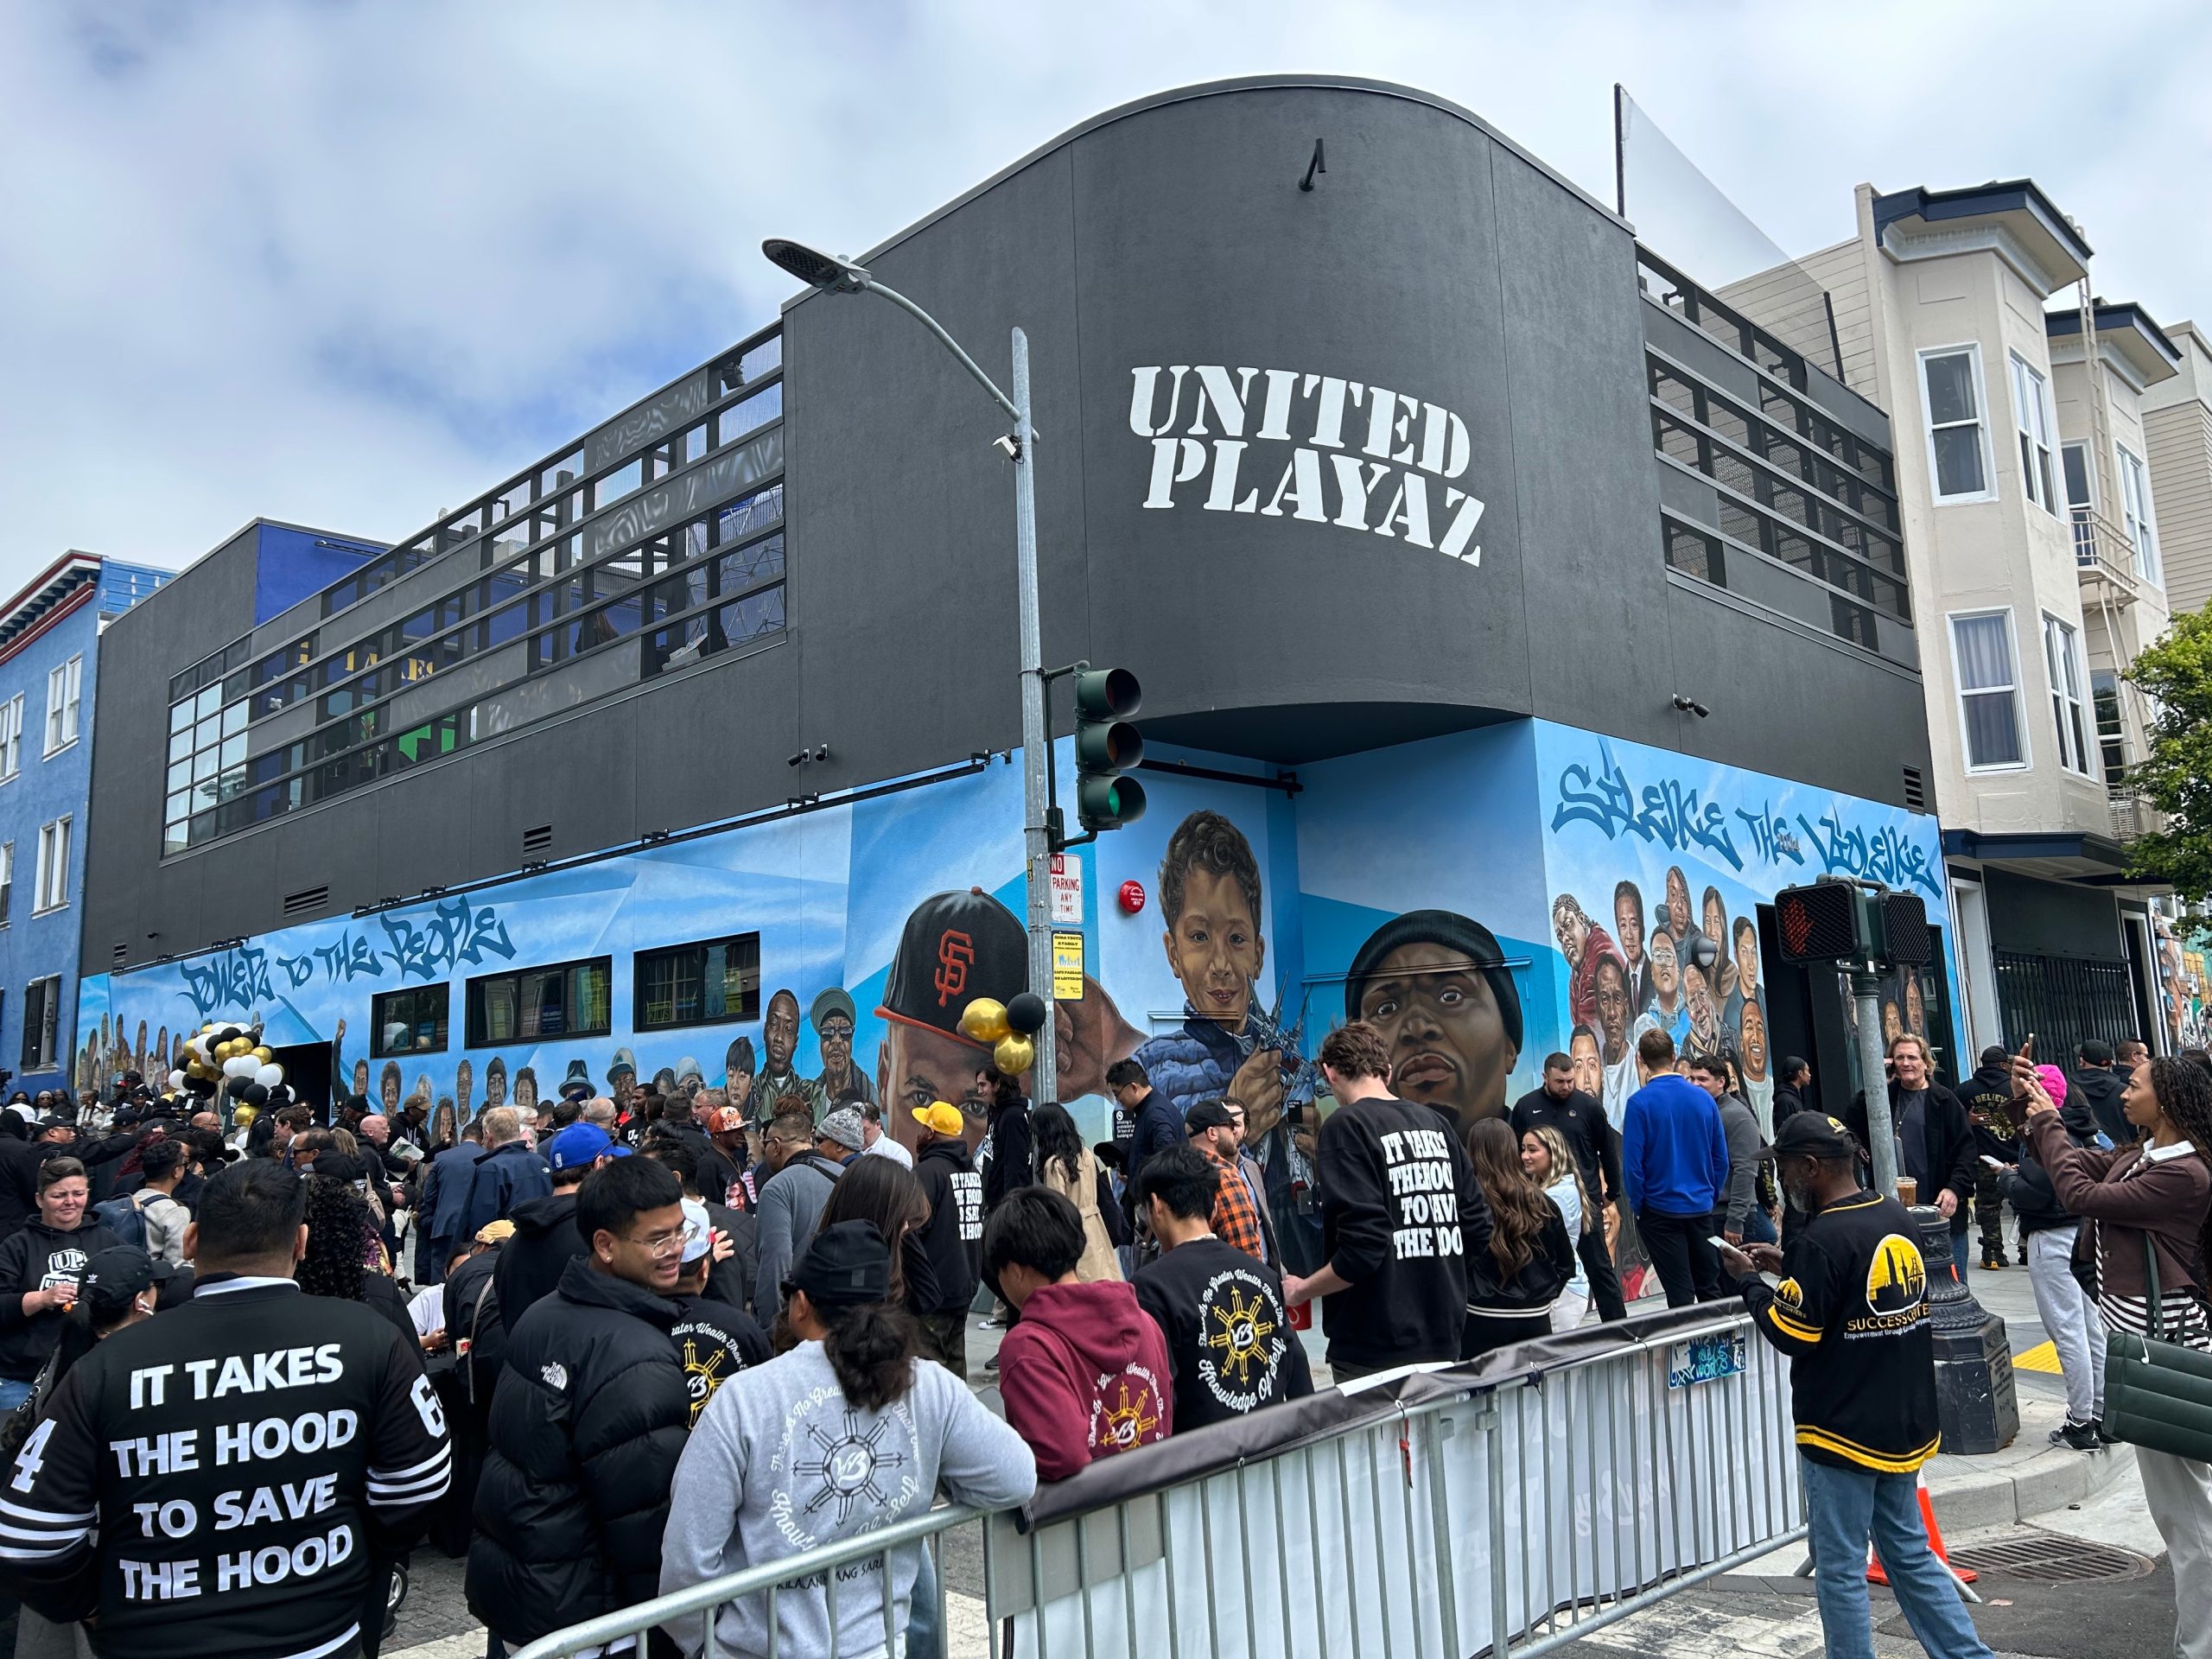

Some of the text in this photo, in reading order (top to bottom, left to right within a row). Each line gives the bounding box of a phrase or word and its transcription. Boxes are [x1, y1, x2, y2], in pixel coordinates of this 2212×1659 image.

[1129, 365, 1471, 479] UNITED
[1142, 437, 1484, 568] PLAYAZ
[1735, 799, 1804, 867] THE
[1051, 856, 1063, 872] NO
[1052, 877, 1079, 891] PARKING
[1060, 893, 1072, 902] ANY
[1060, 904, 1074, 914] TIME
[175, 893, 517, 1019] POWER TO THE PEOPLE
[1380, 1132, 1405, 1164] IT
[1388, 1163, 1425, 1196] THE
[1401, 1195, 1429, 1225] TO
[1393, 1228, 1433, 1260] THE
[696, 1322, 728, 1344] Wealth
[1844, 1331, 1884, 1340] Empowerment
[130, 1344, 344, 1409] IT TAKES
[1198, 1359, 1258, 1414] Knowledge
[793, 1400, 811, 1417] No
[809, 1385, 843, 1407] Grea
[110, 1408, 358, 1478] THE HOOD
[133, 1471, 338, 1538] TO SAVE
[119, 1523, 353, 1600] THE HOOD
